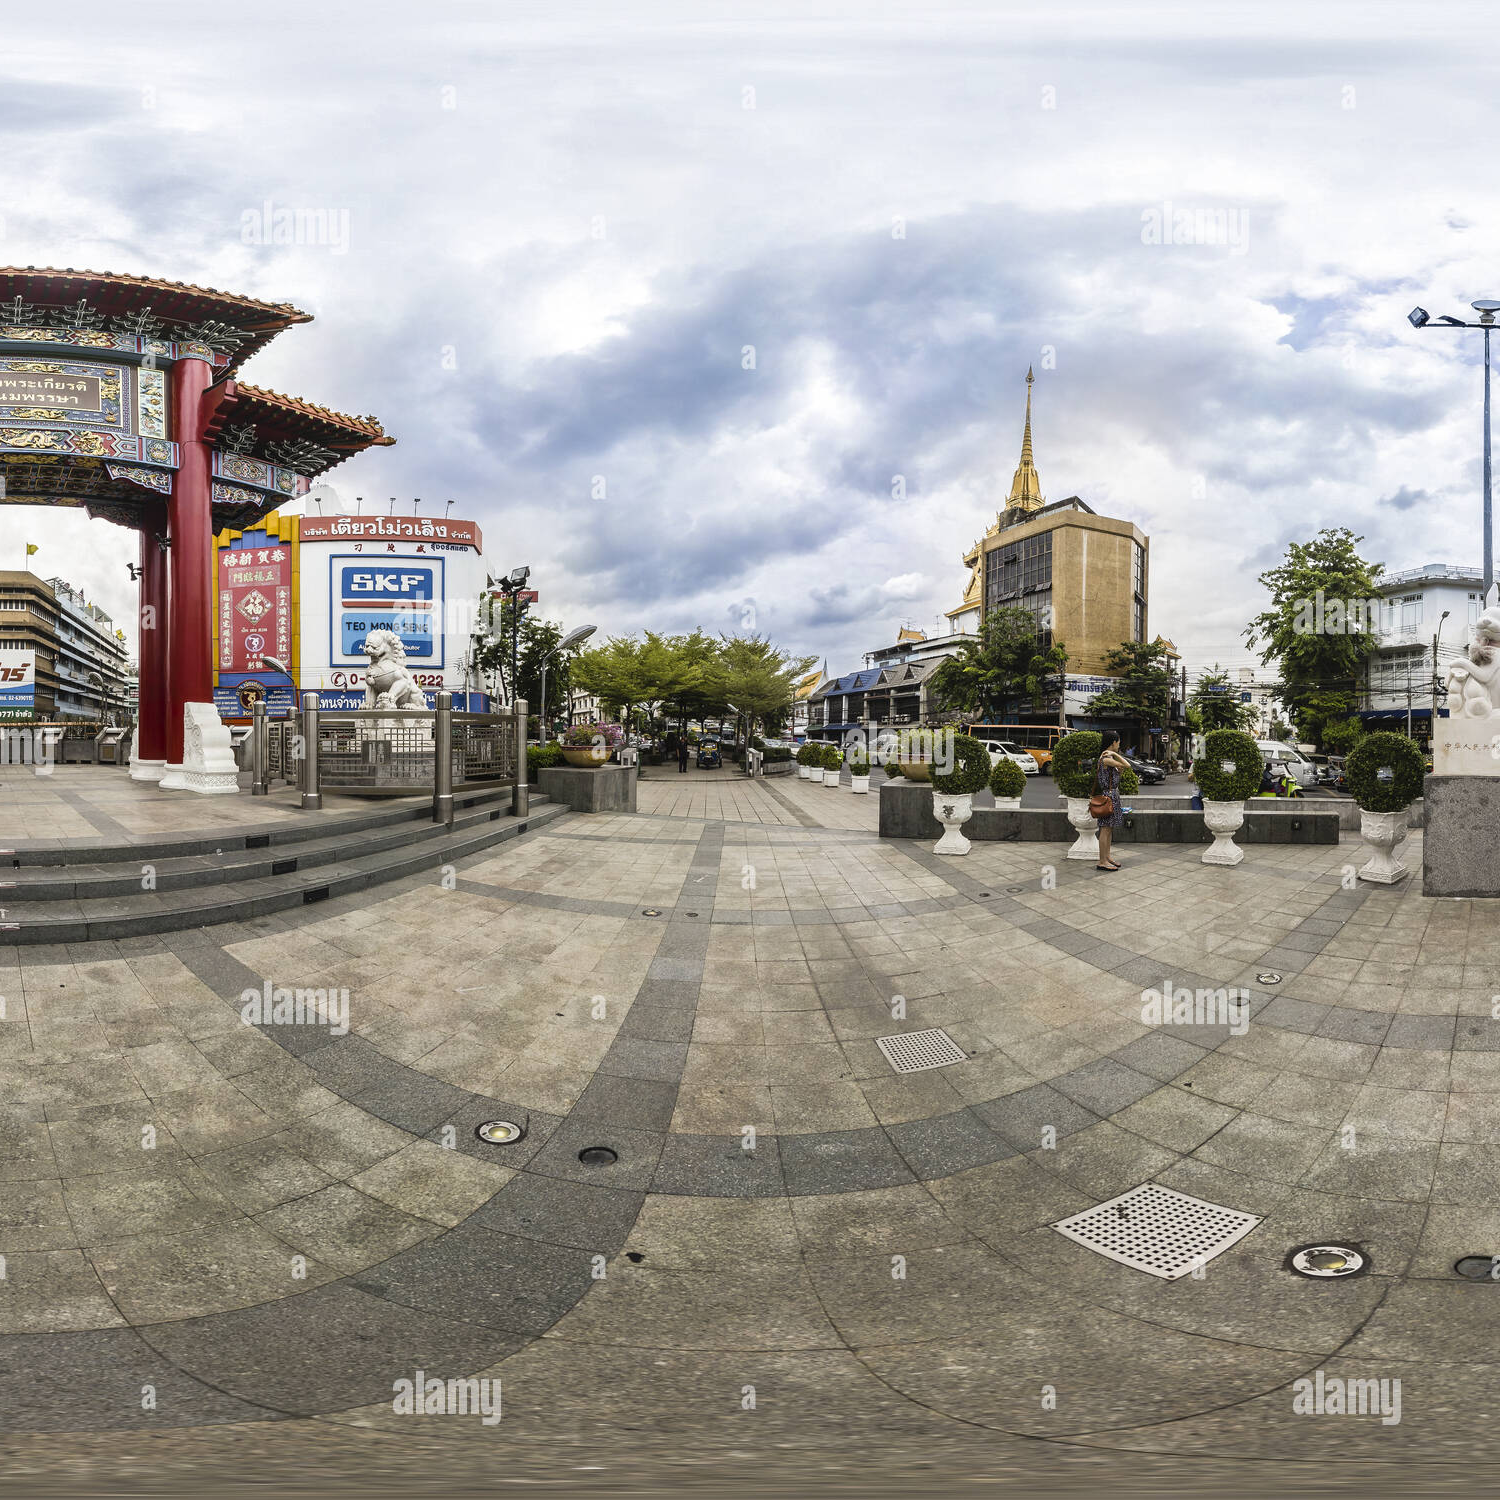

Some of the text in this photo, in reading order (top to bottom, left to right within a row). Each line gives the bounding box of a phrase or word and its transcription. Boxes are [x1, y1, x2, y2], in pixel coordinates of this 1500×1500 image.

[304, 527, 328, 536] บริษัท
[451, 530, 471, 539] จำกัด
[351, 574, 425, 591] SKF
[346, 621, 429, 632] TEO MONG SENG
